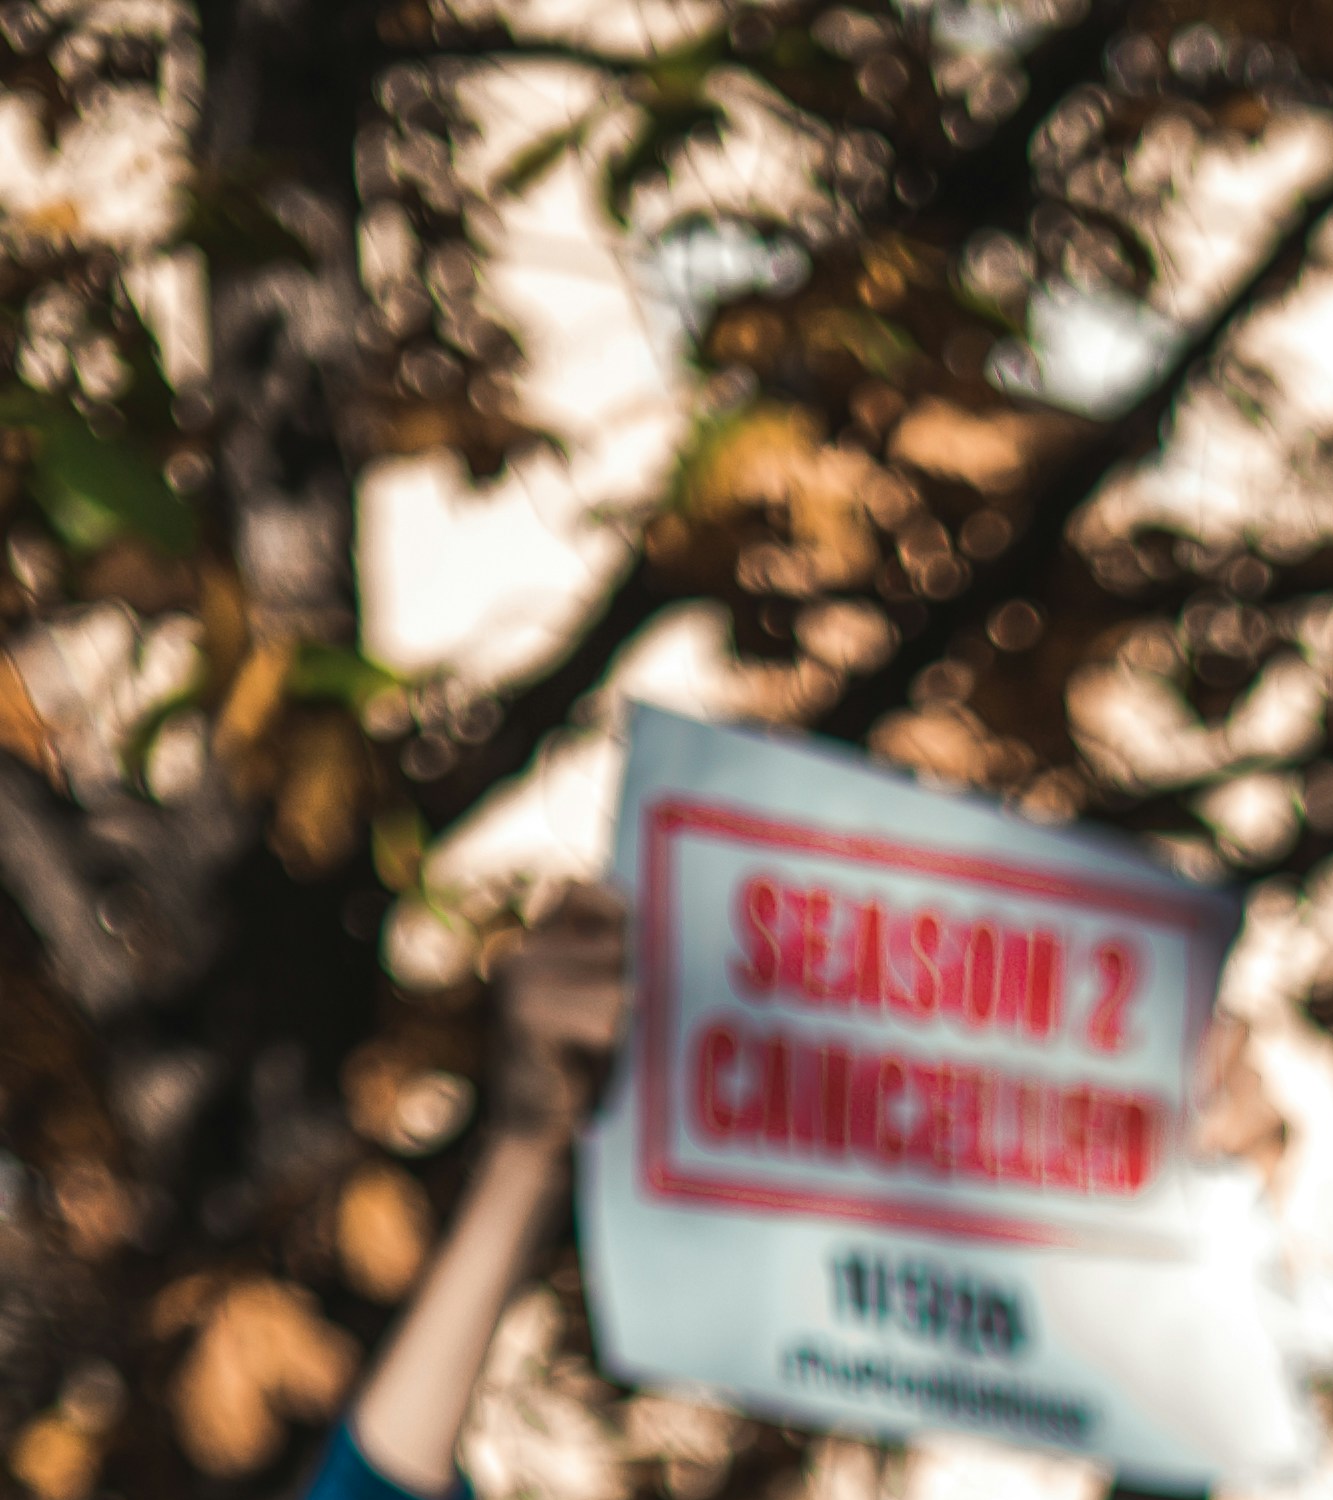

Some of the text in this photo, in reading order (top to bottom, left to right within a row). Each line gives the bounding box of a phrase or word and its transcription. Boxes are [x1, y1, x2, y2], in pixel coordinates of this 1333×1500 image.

[738, 874, 1144, 1054] SEASON 2
[692, 1024, 1158, 1198] CANCELLED
